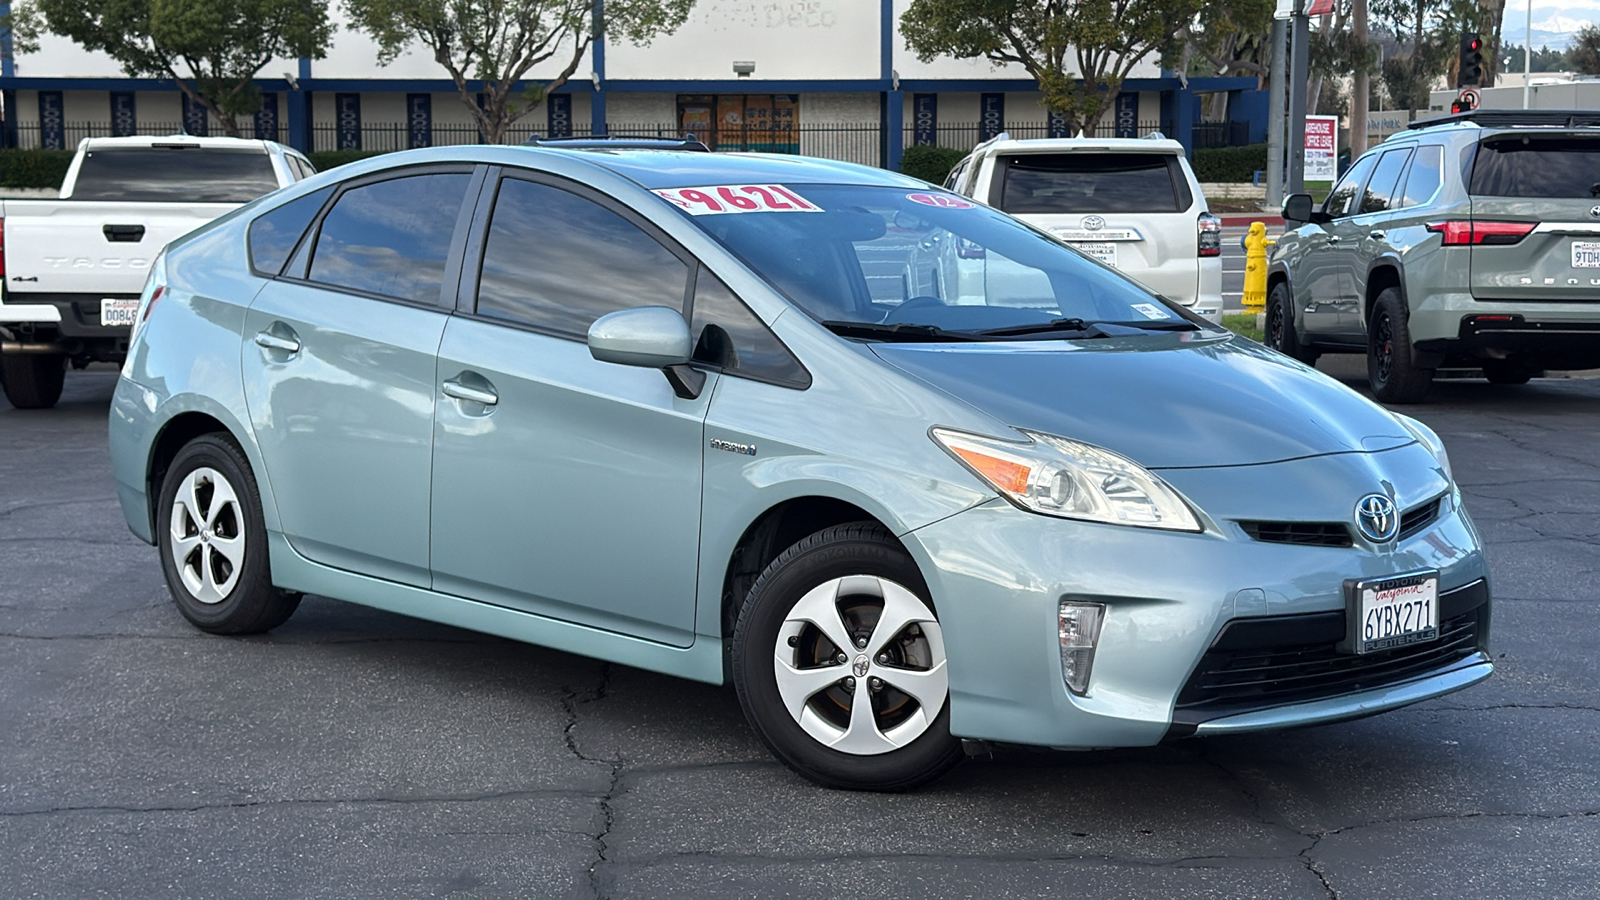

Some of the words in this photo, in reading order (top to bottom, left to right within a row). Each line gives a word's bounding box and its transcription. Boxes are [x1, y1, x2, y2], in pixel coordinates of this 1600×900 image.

[710, 438, 749, 455] HYBRID
[1381, 576, 1423, 589] TOYOTA
[1375, 585, 1423, 603] California
[1365, 599, 1433, 641] 6YBX271
[1366, 634, 1404, 651] PUENTE
[1406, 631, 1436, 642] HILLS
